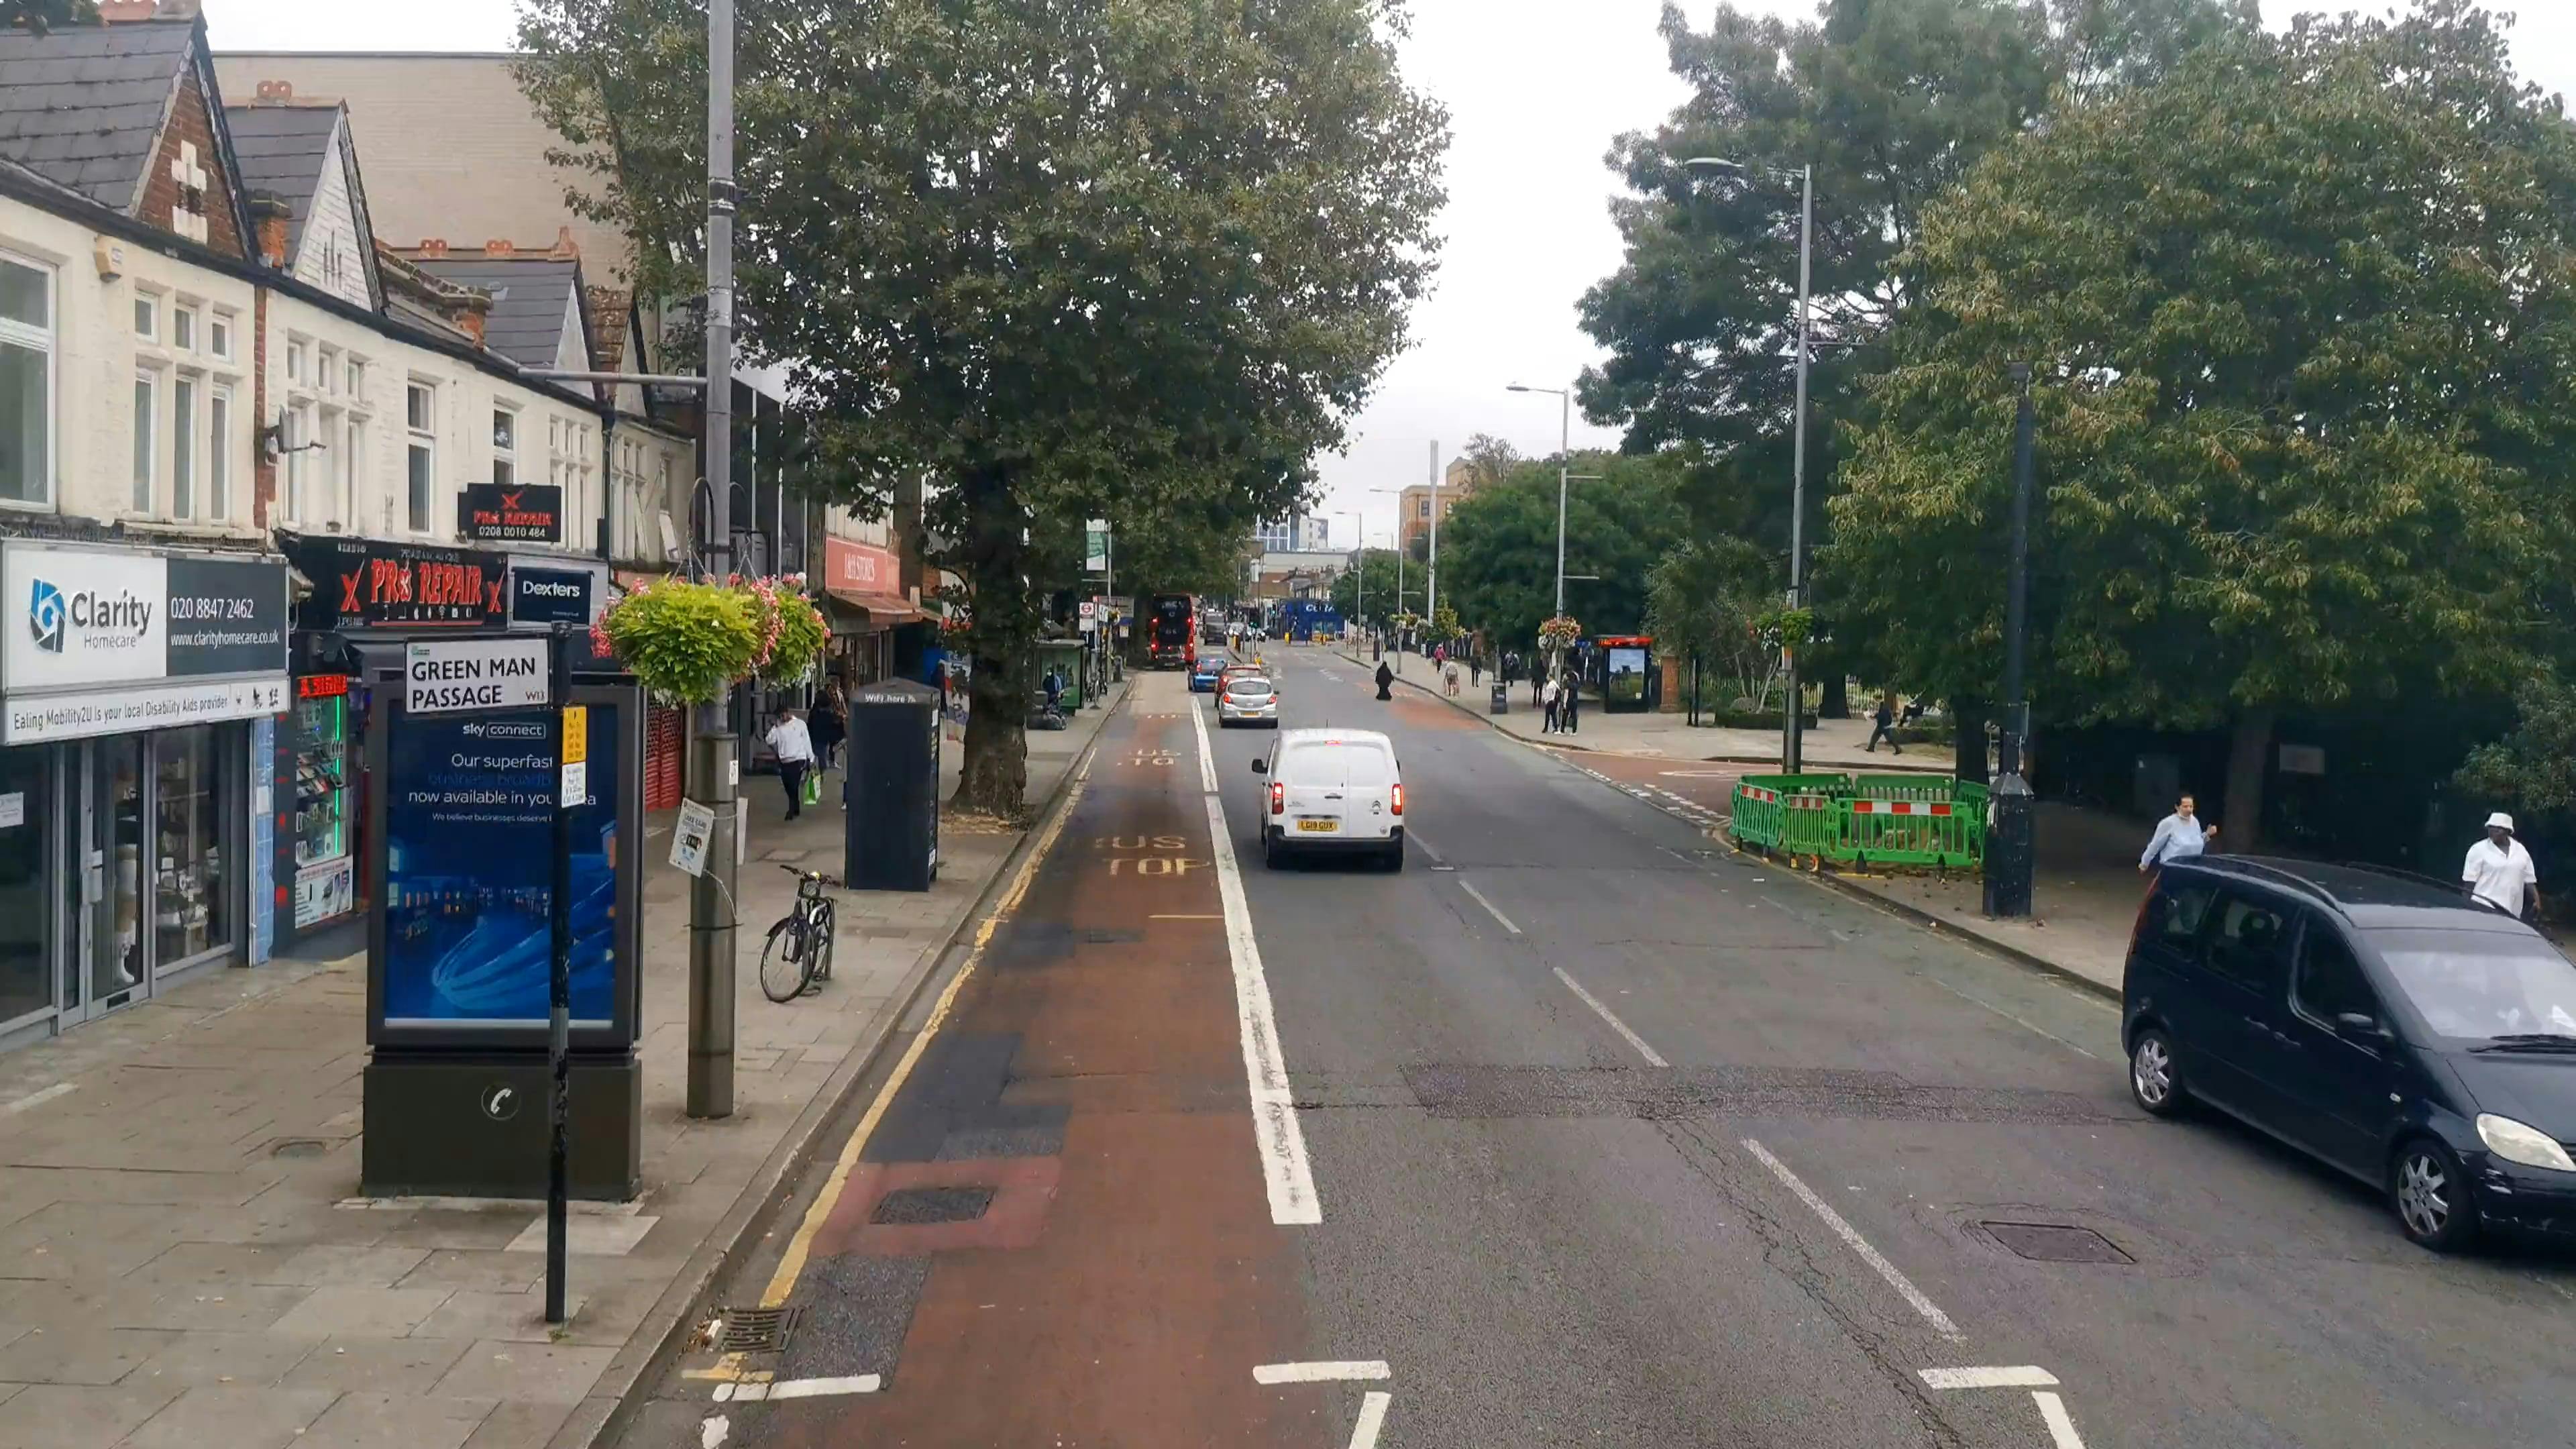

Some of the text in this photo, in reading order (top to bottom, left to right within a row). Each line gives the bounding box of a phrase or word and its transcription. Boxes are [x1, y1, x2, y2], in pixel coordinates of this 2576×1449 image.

[504, 512, 552, 526] REPAIR
[479, 527, 501, 536] 0208
[419, 561, 482, 605] REPAIR
[523, 580, 580, 597] Dexters
[71, 589, 152, 635] Clarity
[171, 598, 254, 619] 020 8847 2462
[85, 635, 136, 649] Homecare
[171, 629, 279, 649] www.clarityhomecare.co.uk
[412, 657, 535, 682] GREEN MAN
[413, 685, 502, 709] PASSAGE
[14, 712, 43, 731] Ealing
[46, 706, 92, 727] Mobility2U
[104, 708, 121, 724] your
[125, 702, 144, 718] local
[146, 698, 180, 718] Disability
[200, 695, 228, 714] provider
[463, 722, 542, 737] sky connect
[451, 753, 480, 768] Our
[409, 789, 552, 808] now available in you
